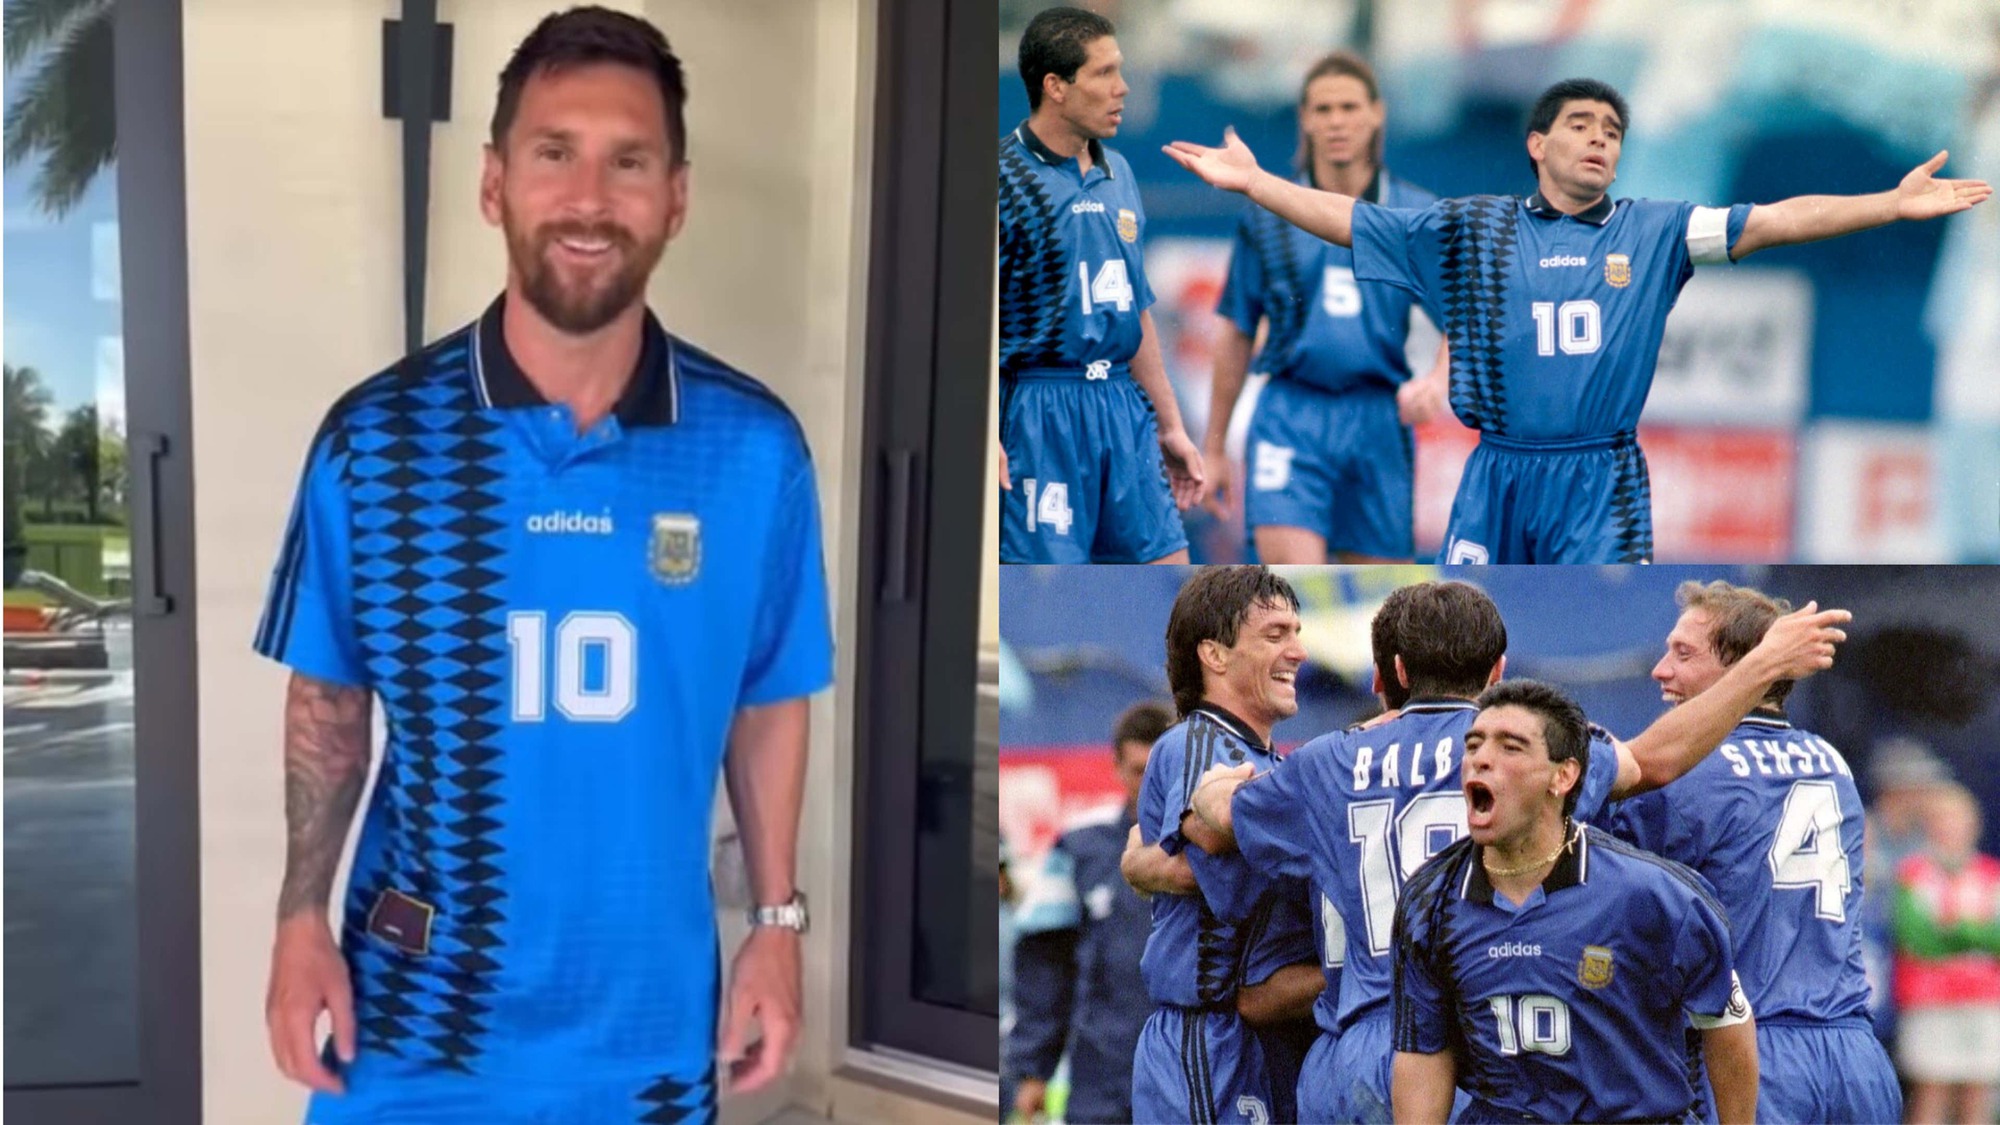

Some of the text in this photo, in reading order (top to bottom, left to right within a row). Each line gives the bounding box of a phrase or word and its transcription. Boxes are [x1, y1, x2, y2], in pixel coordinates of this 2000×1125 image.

[1071, 199, 1105, 214] addas
[1078, 258, 1134, 315] 14
[1539, 254, 1588, 269] adidas
[1322, 265, 1362, 318] 5
[1531, 299, 1602, 357] 10
[1253, 440, 1295, 491] 5
[526, 509, 613, 534] adidas
[1023, 478, 1073, 536] 14
[506, 611, 637, 723] 10
[1353, 736, 1453, 791] BALB
[1769, 780, 1852, 923] 4
[1488, 942, 1542, 959] adidas
[1489, 995, 1572, 1057] 10
